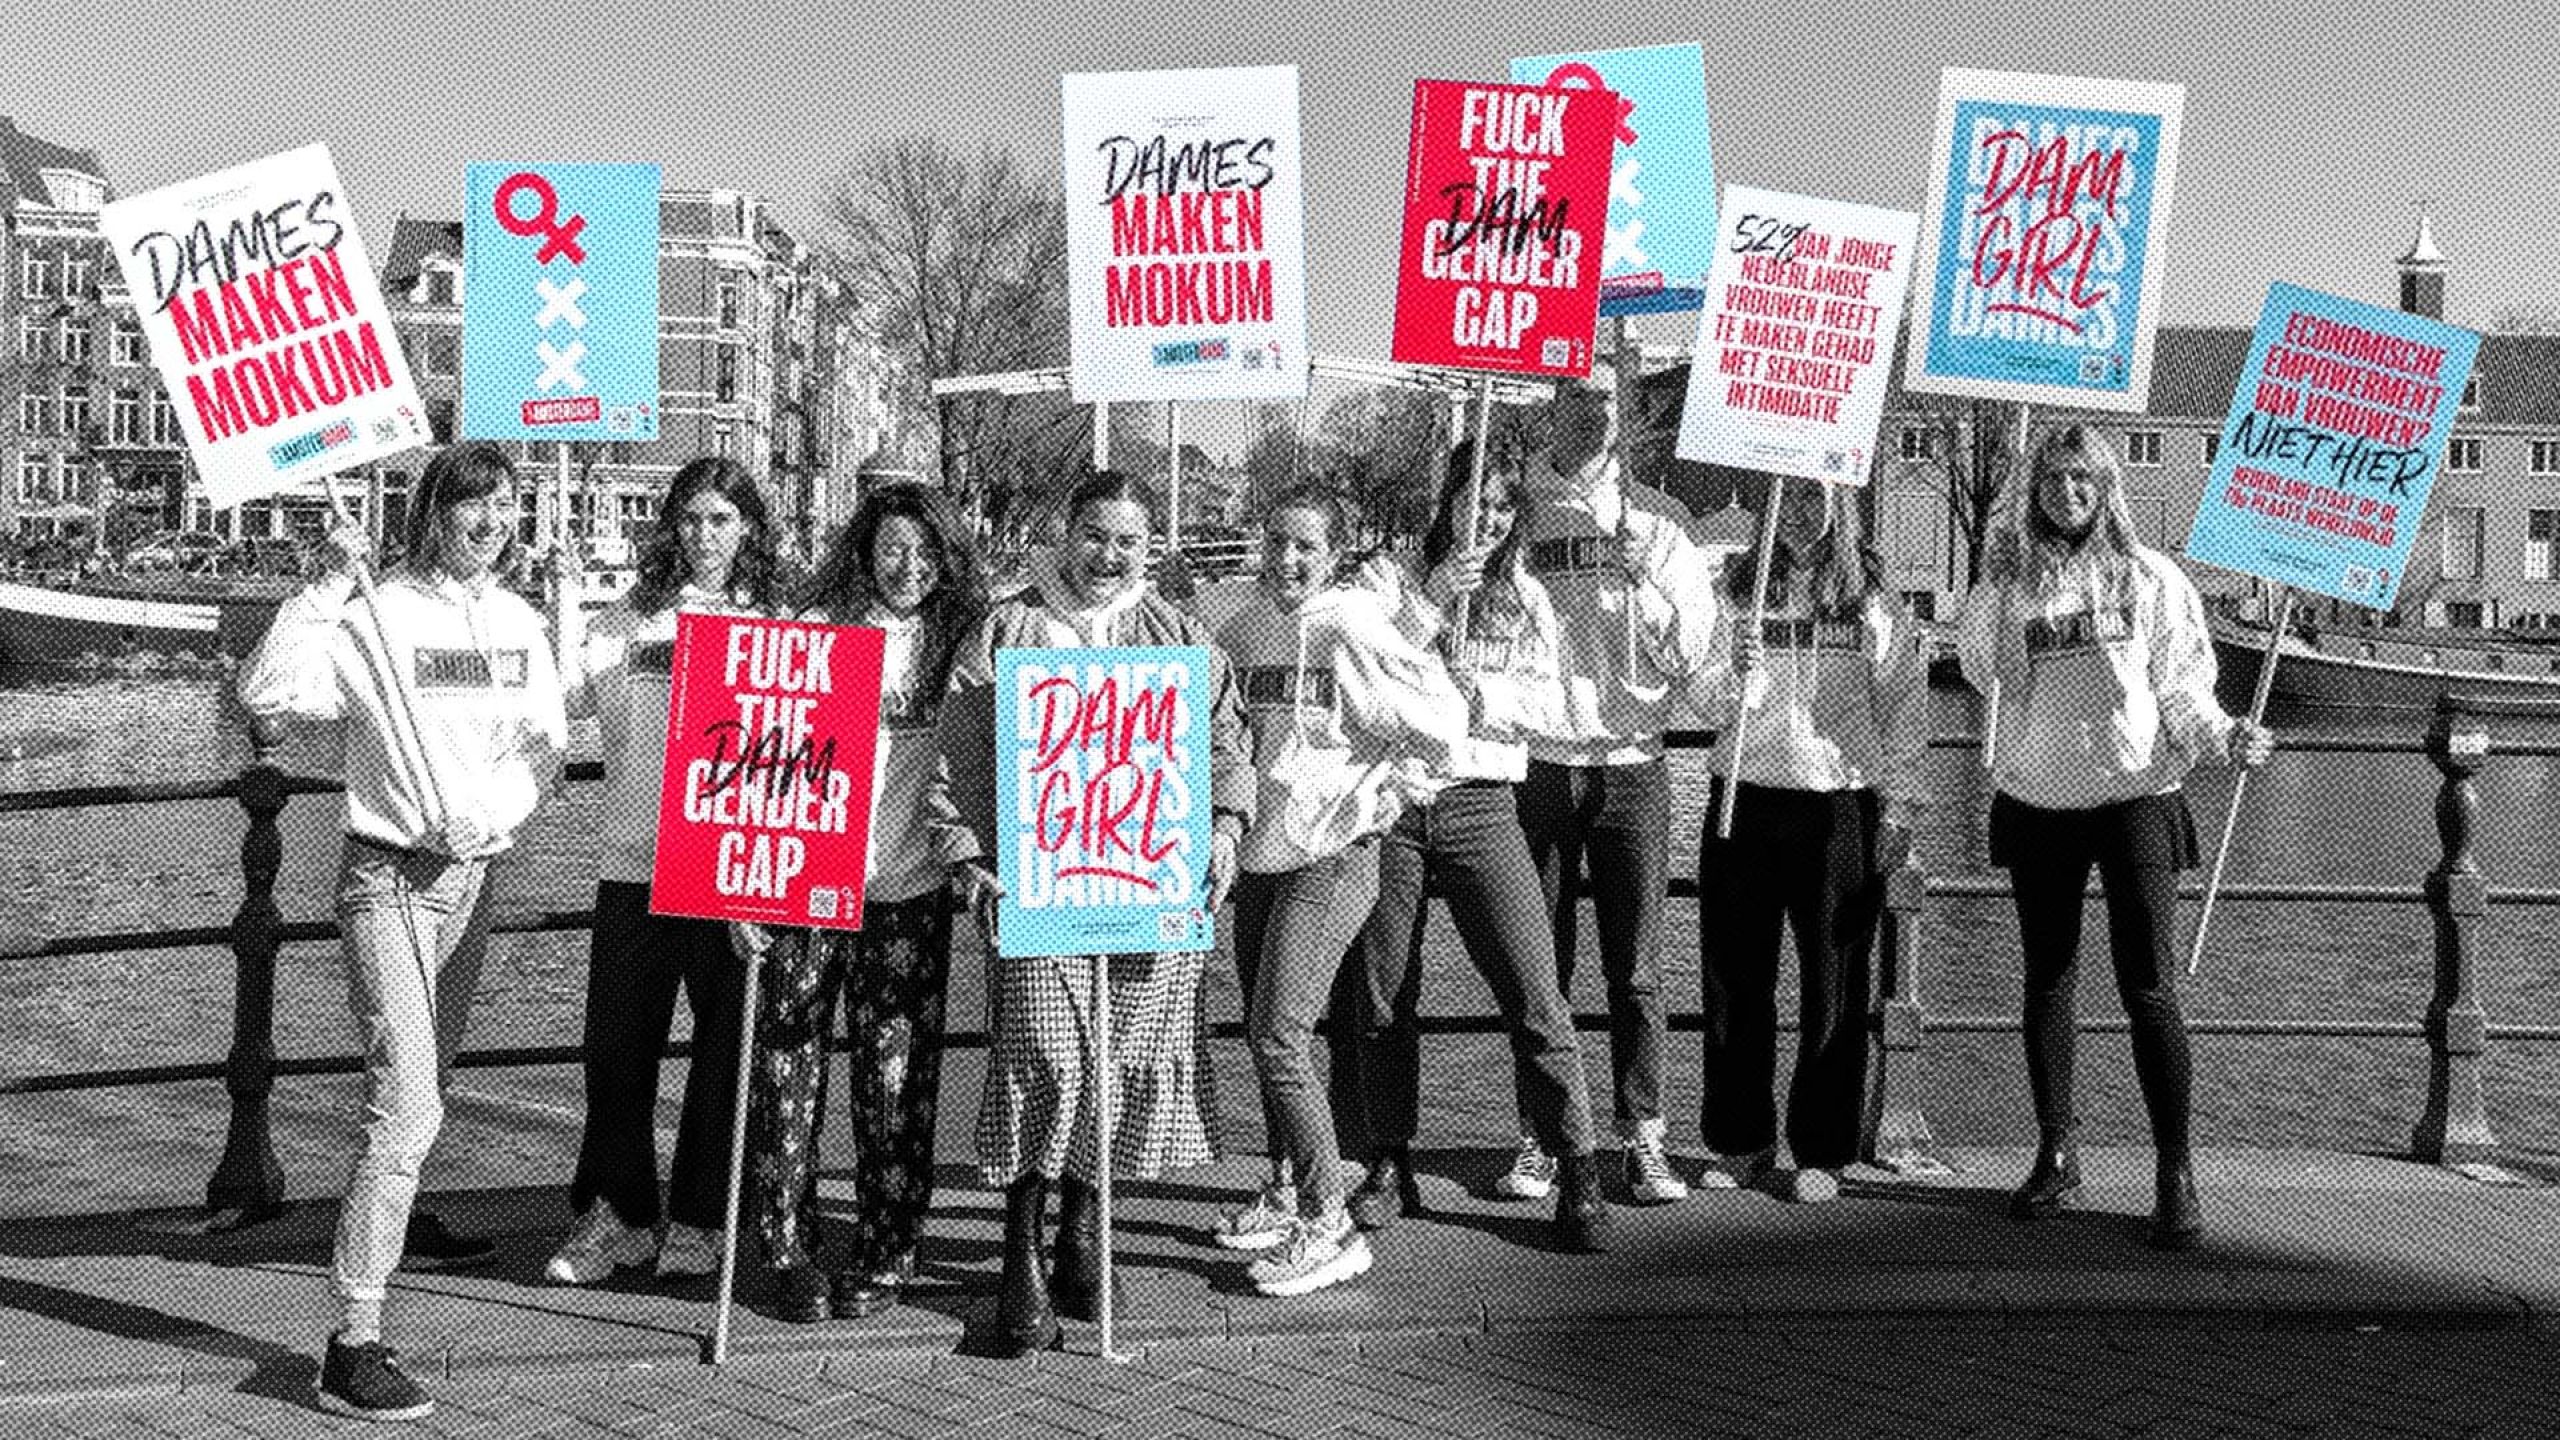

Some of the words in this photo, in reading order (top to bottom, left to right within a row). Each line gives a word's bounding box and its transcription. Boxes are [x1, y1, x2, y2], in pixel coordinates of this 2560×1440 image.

[1459, 88, 1570, 157] FUCK
[1098, 135, 1275, 205] DAMES
[1470, 156, 1551, 222] THE
[1973, 129, 2125, 219] DAM
[131, 191, 344, 314] DAMES
[1112, 188, 1264, 256] MAKEN
[1421, 218, 1583, 289] GENDER
[1434, 182, 1569, 259] DAM
[1730, 213, 1812, 264] 52%
[1794, 231, 1831, 262] VAN
[1834, 237, 1897, 271] JONGE
[1106, 260, 1274, 327] MOKUM
[1740, 254, 1873, 300] NEDERLANDSE
[1971, 211, 2106, 310] GIRL
[168, 246, 358, 364] MAKEN
[1453, 286, 1539, 350] GAP
[1725, 283, 1818, 325] VROUWEN
[1822, 297, 1882, 334] HEEFT
[1714, 314, 1738, 342] TE
[1740, 318, 1808, 354] MAKEN
[1811, 329, 1876, 366] GEHAD
[1719, 347, 1761, 378] MET
[1764, 355, 1858, 394] SEKSUELE
[2284, 311, 2448, 380] ECONOMISCHE
[186, 321, 393, 443] MOKUM
[1725, 380, 1843, 425] INTIMIDATIE
[2254, 381, 2301, 418] VAN
[2304, 393, 2432, 448] VROUWEN?
[2263, 345, 2445, 418] EMPOWERMENT
[2231, 411, 2334, 470] NIET
[2330, 436, 2429, 499] HIER
[724, 624, 837, 694] FUCK
[734, 693, 818, 760] THE
[1028, 677, 1177, 773] DAM
[699, 720, 836, 802] DAM
[683, 758, 850, 834] GENDER
[1036, 760, 1179, 863] GIRL
[715, 830, 806, 899] GAP
